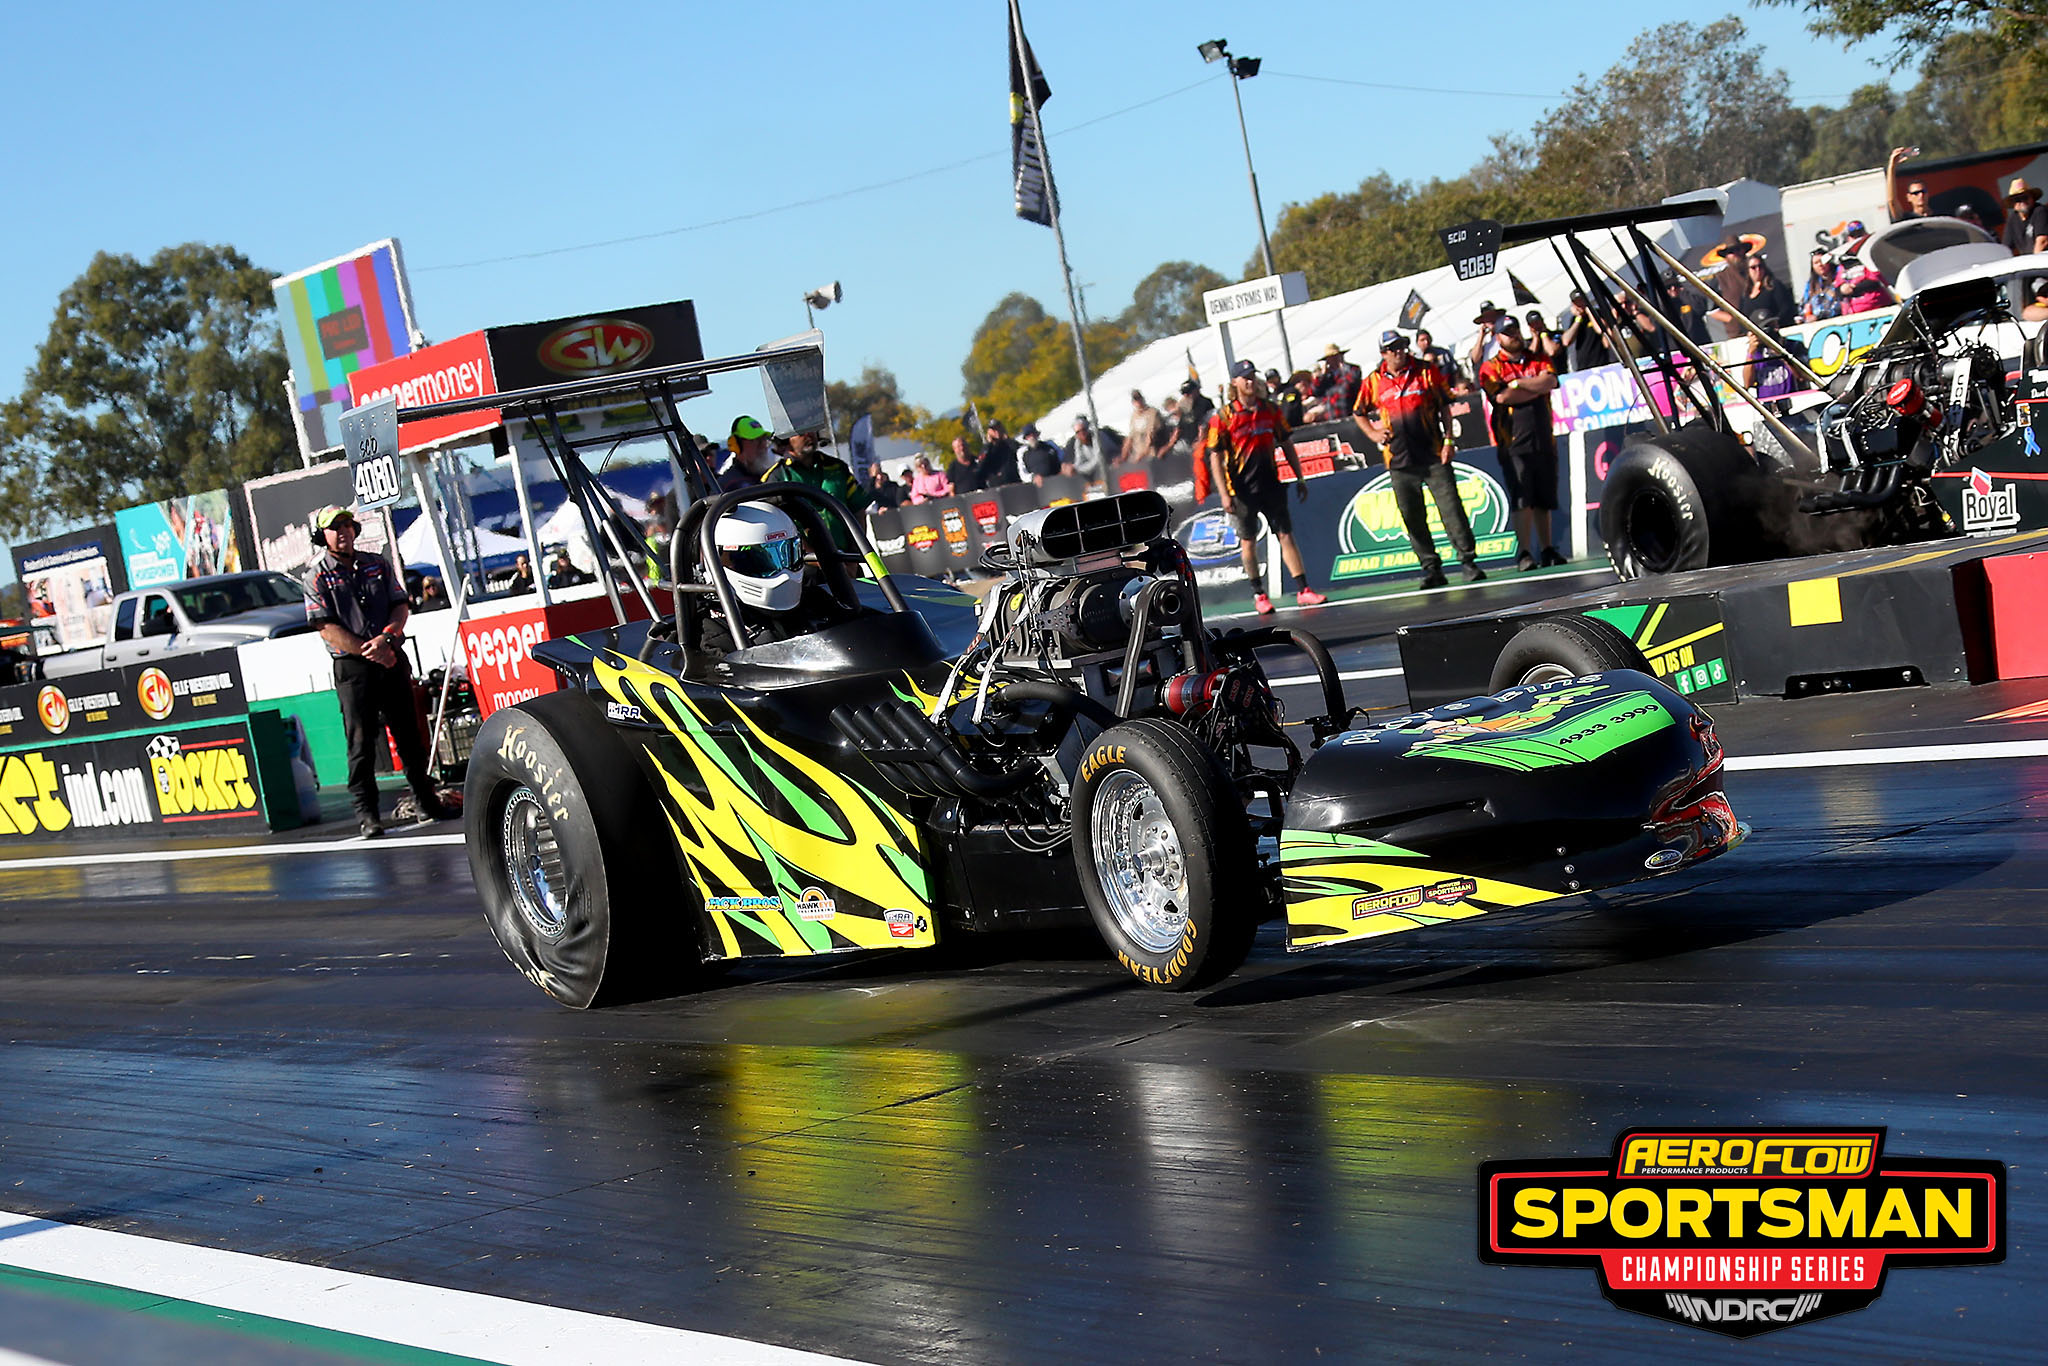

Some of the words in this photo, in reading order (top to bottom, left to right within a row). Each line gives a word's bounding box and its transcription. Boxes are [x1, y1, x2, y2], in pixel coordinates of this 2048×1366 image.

[1459, 253, 1494, 279] 5069
[1209, 296, 1235, 315] DENNIS
[1263, 286, 1278, 301] WAY
[355, 453, 399, 504] 4080
[1647, 457, 1694, 520] Hoosier
[1966, 488, 2014, 522] Royal
[1338, 555, 1381, 574] DRAG
[467, 621, 545, 686] pepper
[1665, 649, 1681, 674] US
[1680, 645, 1696, 668] ON
[1559, 722, 1608, 746] 4933
[1609, 704, 1659, 724] 3999
[497, 724, 569, 821] Hoosier
[1081, 744, 1127, 783] EAGLE
[706, 897, 741, 912] JACK
[796, 901, 834, 910] HAWKEYE
[1356, 890, 1420, 915] AEROFLOW
[1427, 883, 1472, 898] SPORTSMAN
[1119, 918, 1198, 985] GOODYEAR
